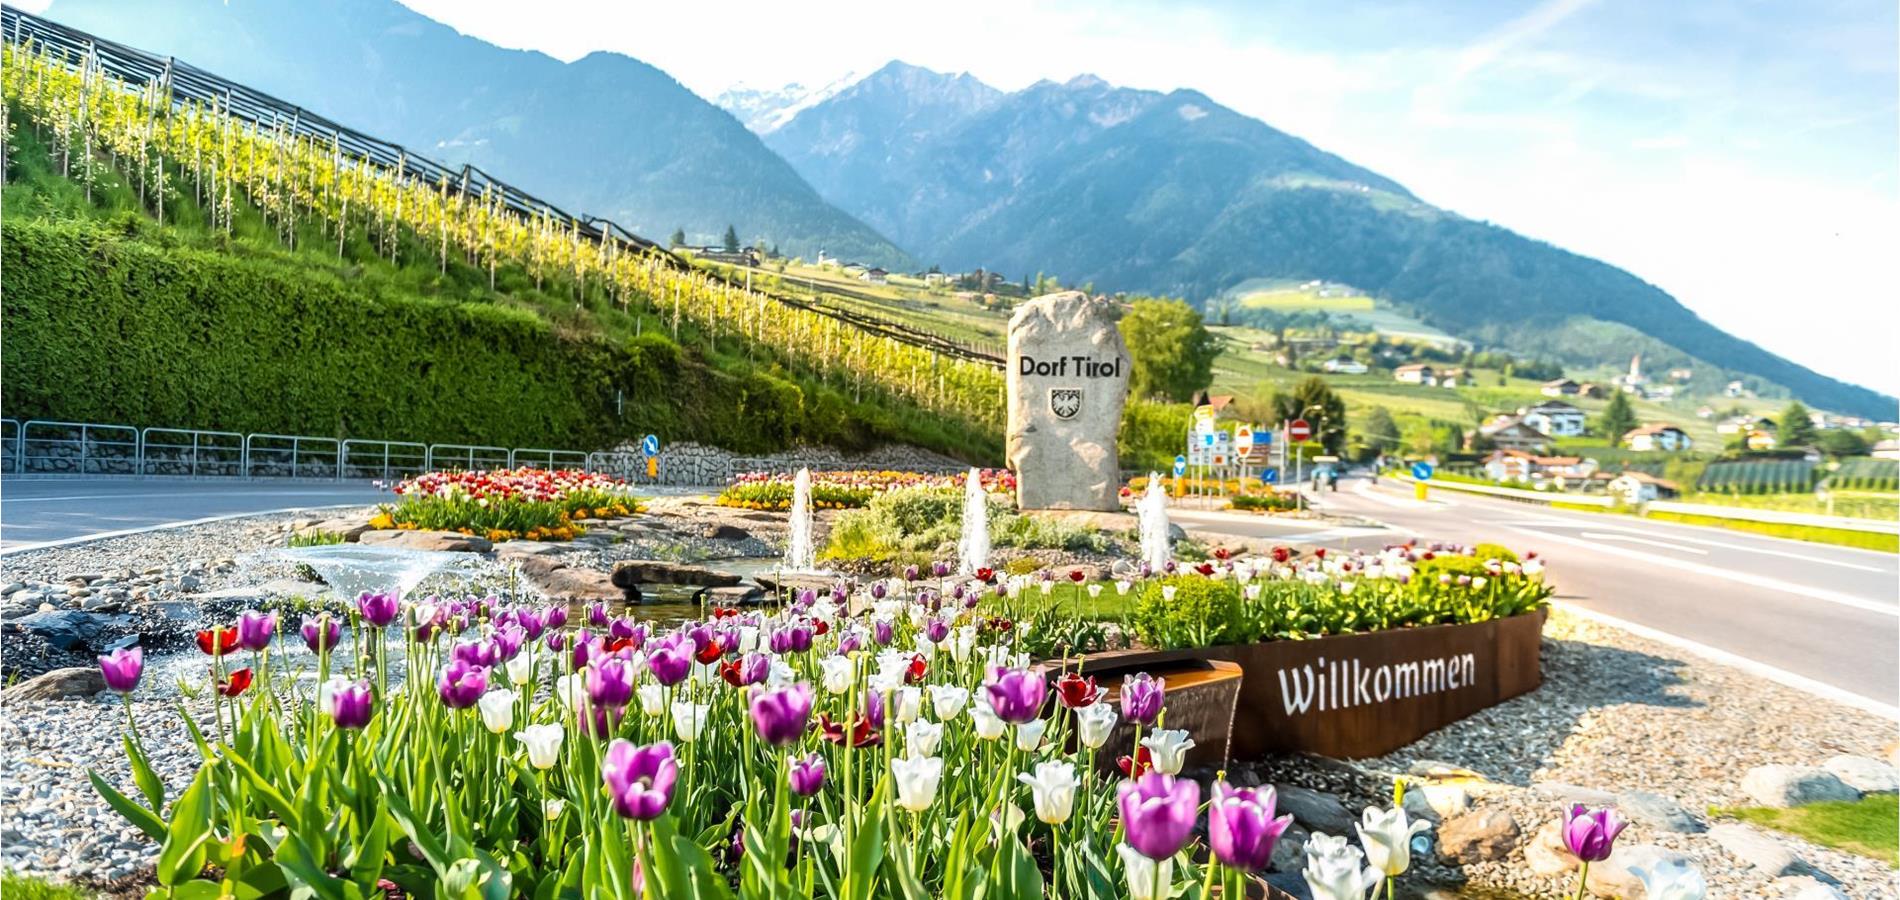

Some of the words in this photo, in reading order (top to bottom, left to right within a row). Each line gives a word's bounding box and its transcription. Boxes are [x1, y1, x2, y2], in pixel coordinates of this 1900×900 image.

[1020, 356, 1067, 376] Dorf
[1072, 356, 1120, 377] Tirol
[1277, 653, 1475, 716] Willkommen
